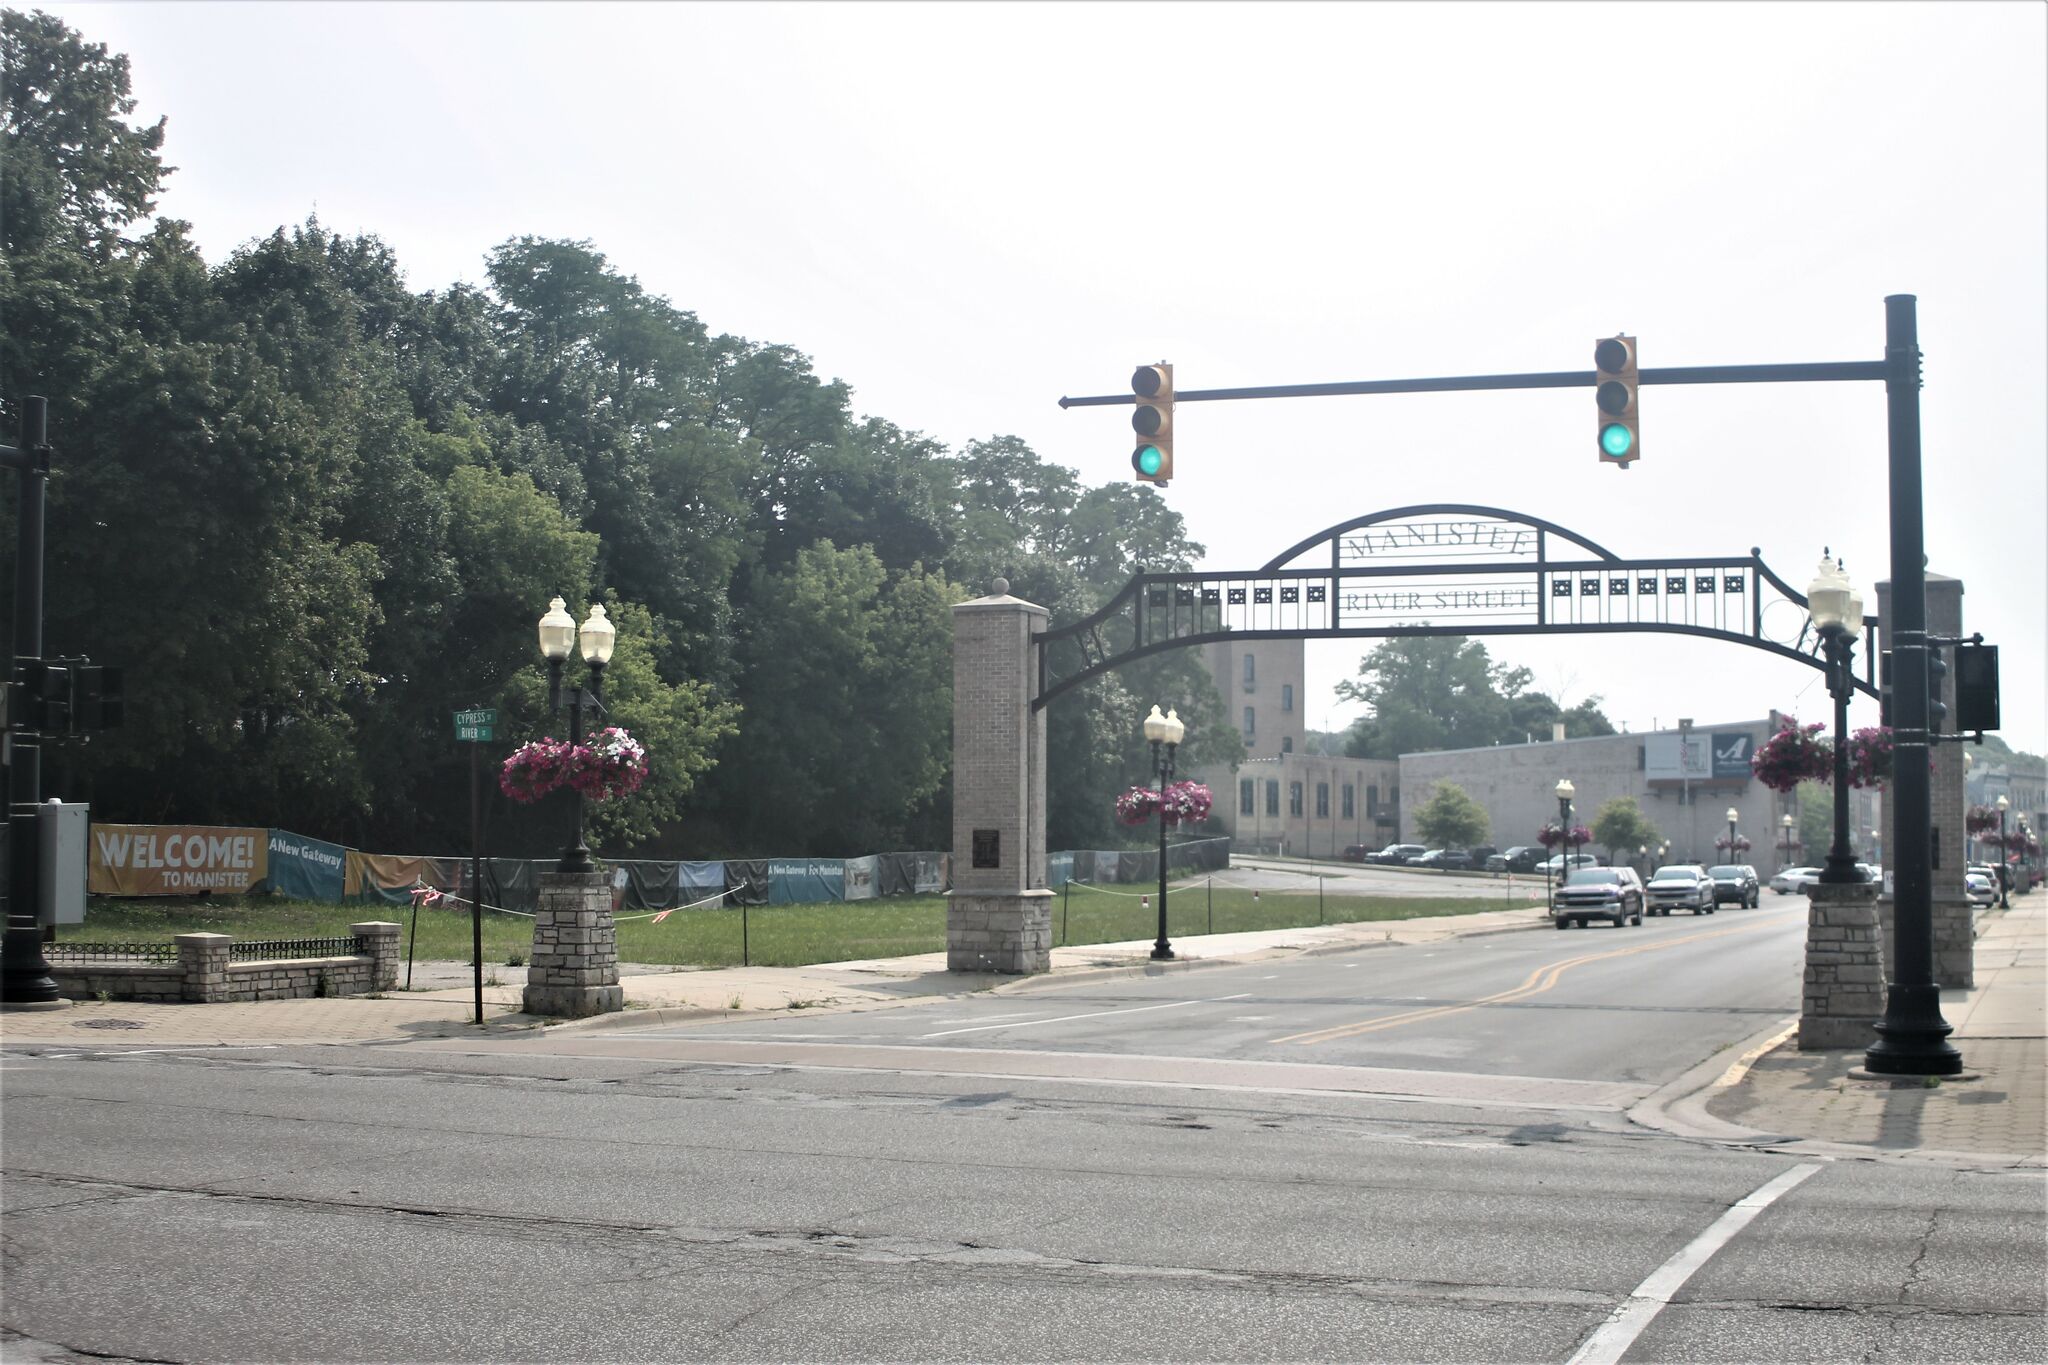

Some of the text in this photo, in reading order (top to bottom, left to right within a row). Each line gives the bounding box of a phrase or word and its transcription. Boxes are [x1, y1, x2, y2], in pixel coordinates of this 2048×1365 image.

[1348, 523, 1530, 560] MANISTEE
[1347, 589, 1530, 611] RIVER STREET
[457, 712, 486, 724] CYPRESS
[461, 728, 478, 738] RIVER
[97, 832, 254, 868] WELCOME!
[269, 838, 342, 870] A New Gateway
[768, 864, 773, 875] A
[162, 872, 248, 887] TO MANISTEE
